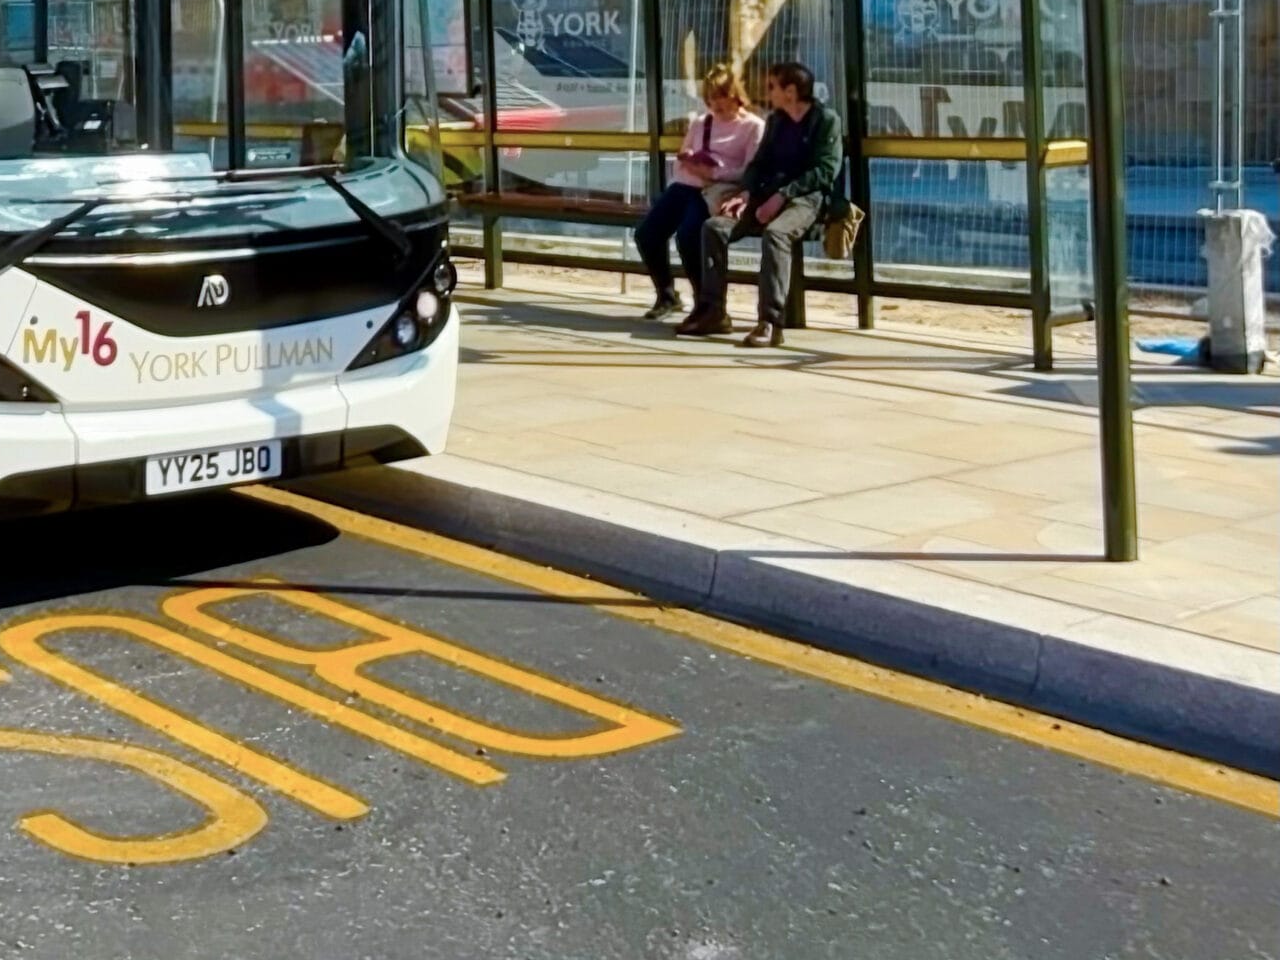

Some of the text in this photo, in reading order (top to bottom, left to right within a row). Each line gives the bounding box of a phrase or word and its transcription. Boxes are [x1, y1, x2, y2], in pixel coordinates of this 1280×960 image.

[547, 10, 622, 37] YORK
[128, 336, 334, 384] YORK PULLMAN
[158, 451, 219, 486] YY25
